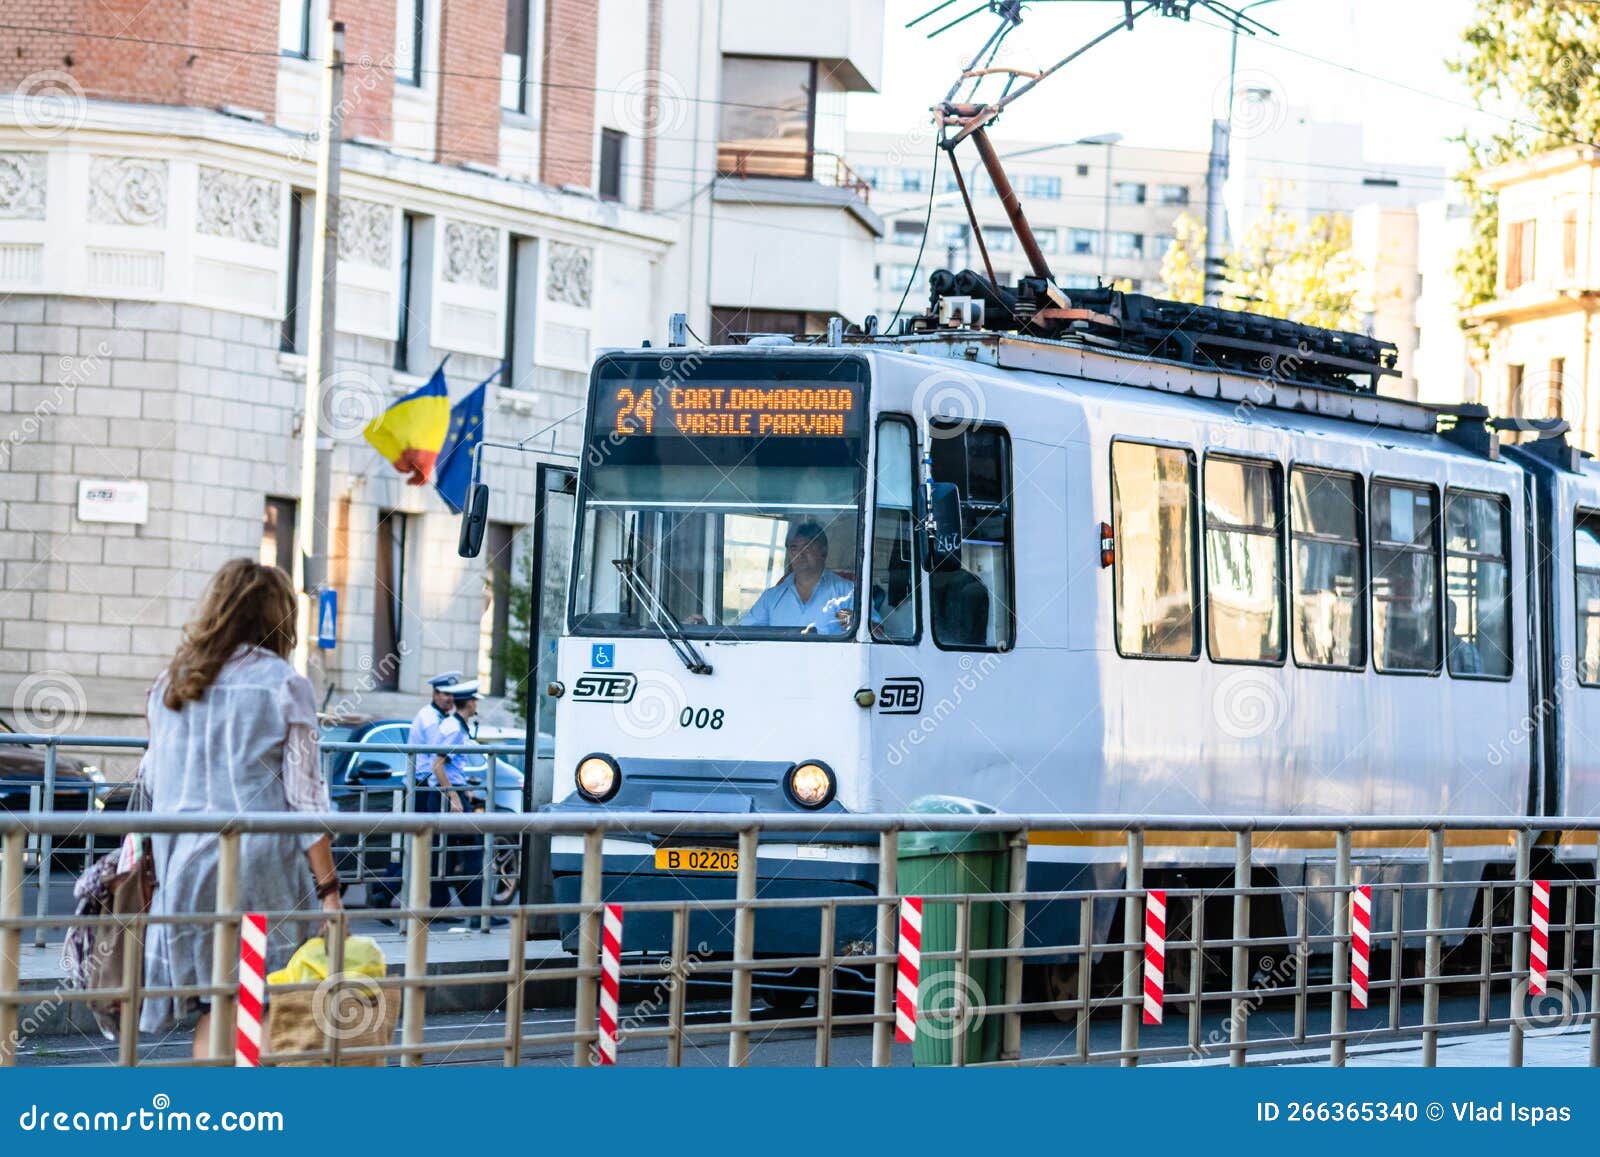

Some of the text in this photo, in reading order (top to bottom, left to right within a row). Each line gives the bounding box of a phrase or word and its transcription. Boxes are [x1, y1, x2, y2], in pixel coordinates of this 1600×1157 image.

[670, 388, 852, 410] CART.DAMAROAIA
[616, 388, 654, 433] 24
[676, 413, 844, 434] VASILE PARVAN
[572, 676, 632, 698] STB
[878, 683, 920, 708] STB
[679, 706, 725, 730] 008
[668, 851, 739, 869] B 02203
